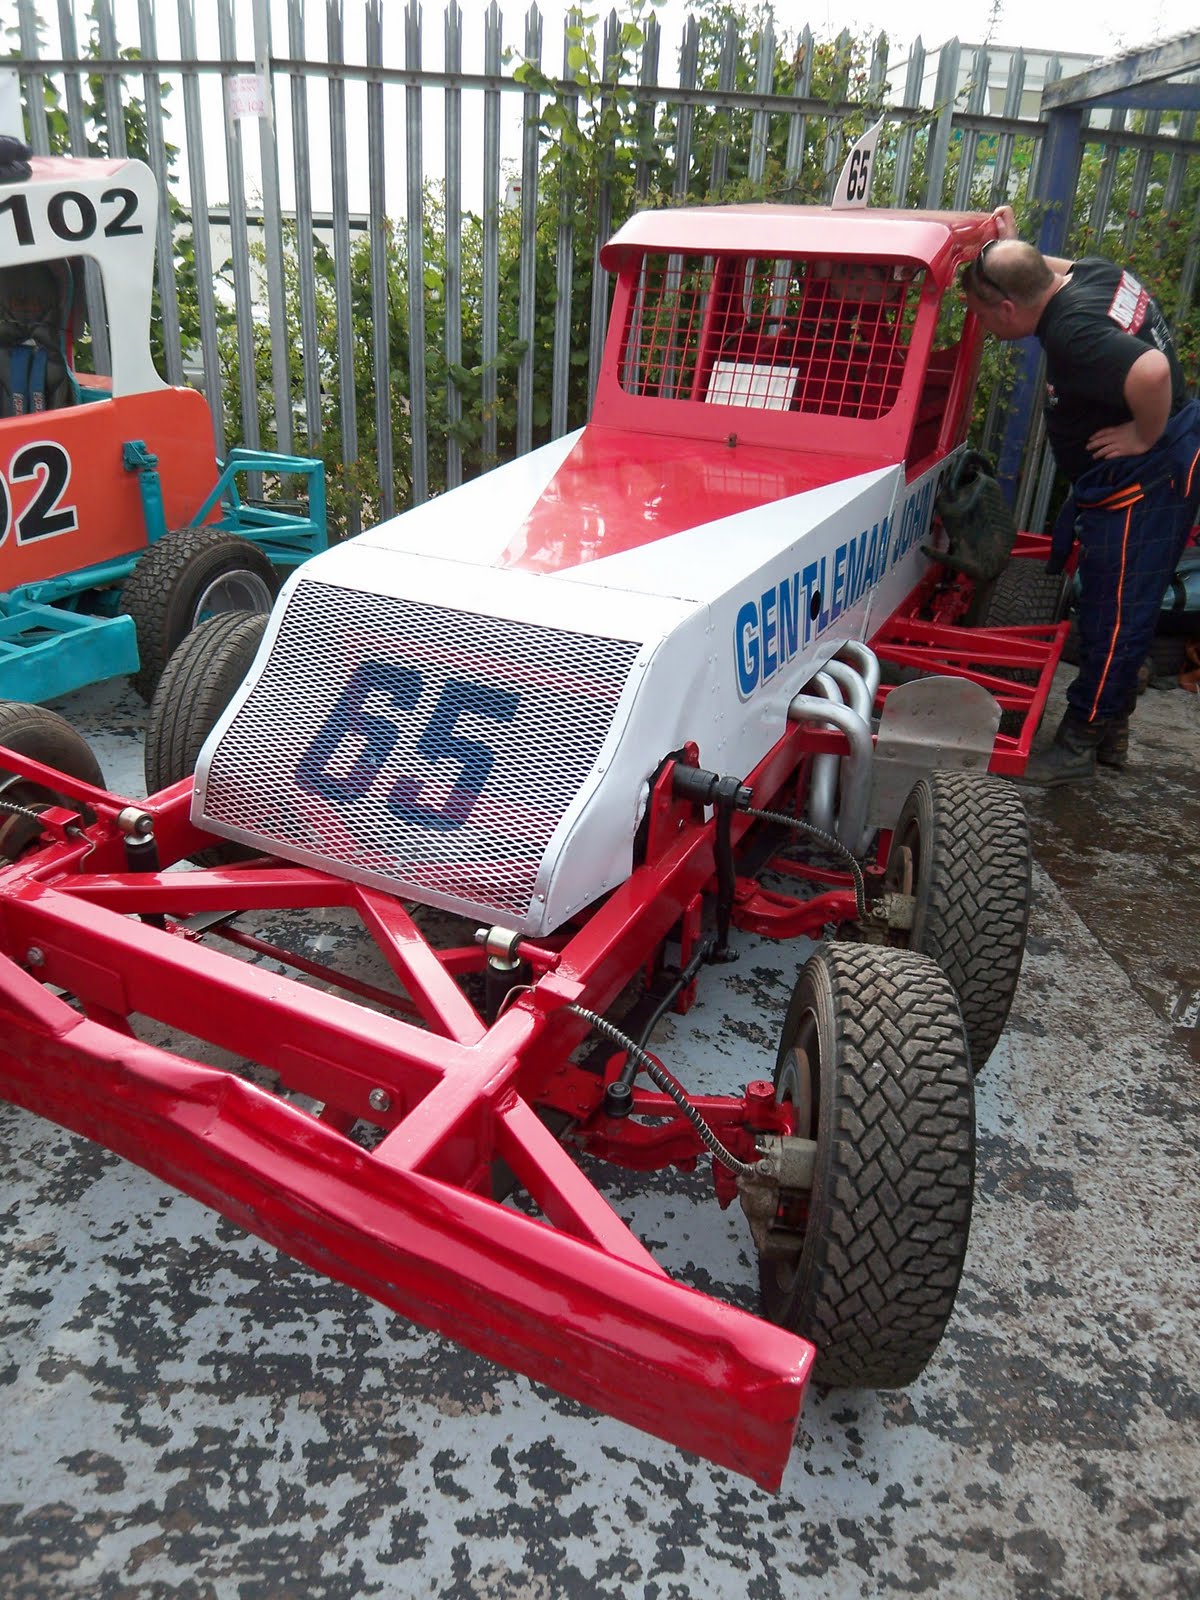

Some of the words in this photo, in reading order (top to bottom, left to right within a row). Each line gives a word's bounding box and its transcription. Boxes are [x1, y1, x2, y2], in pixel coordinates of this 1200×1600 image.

[0, 187, 144, 247] 102
[846, 149, 871, 201] 65
[0, 440, 79, 547] 2
[733, 510, 895, 702] GENTLEMAN
[890, 477, 935, 569] JOHN
[294, 659, 522, 832] 65
